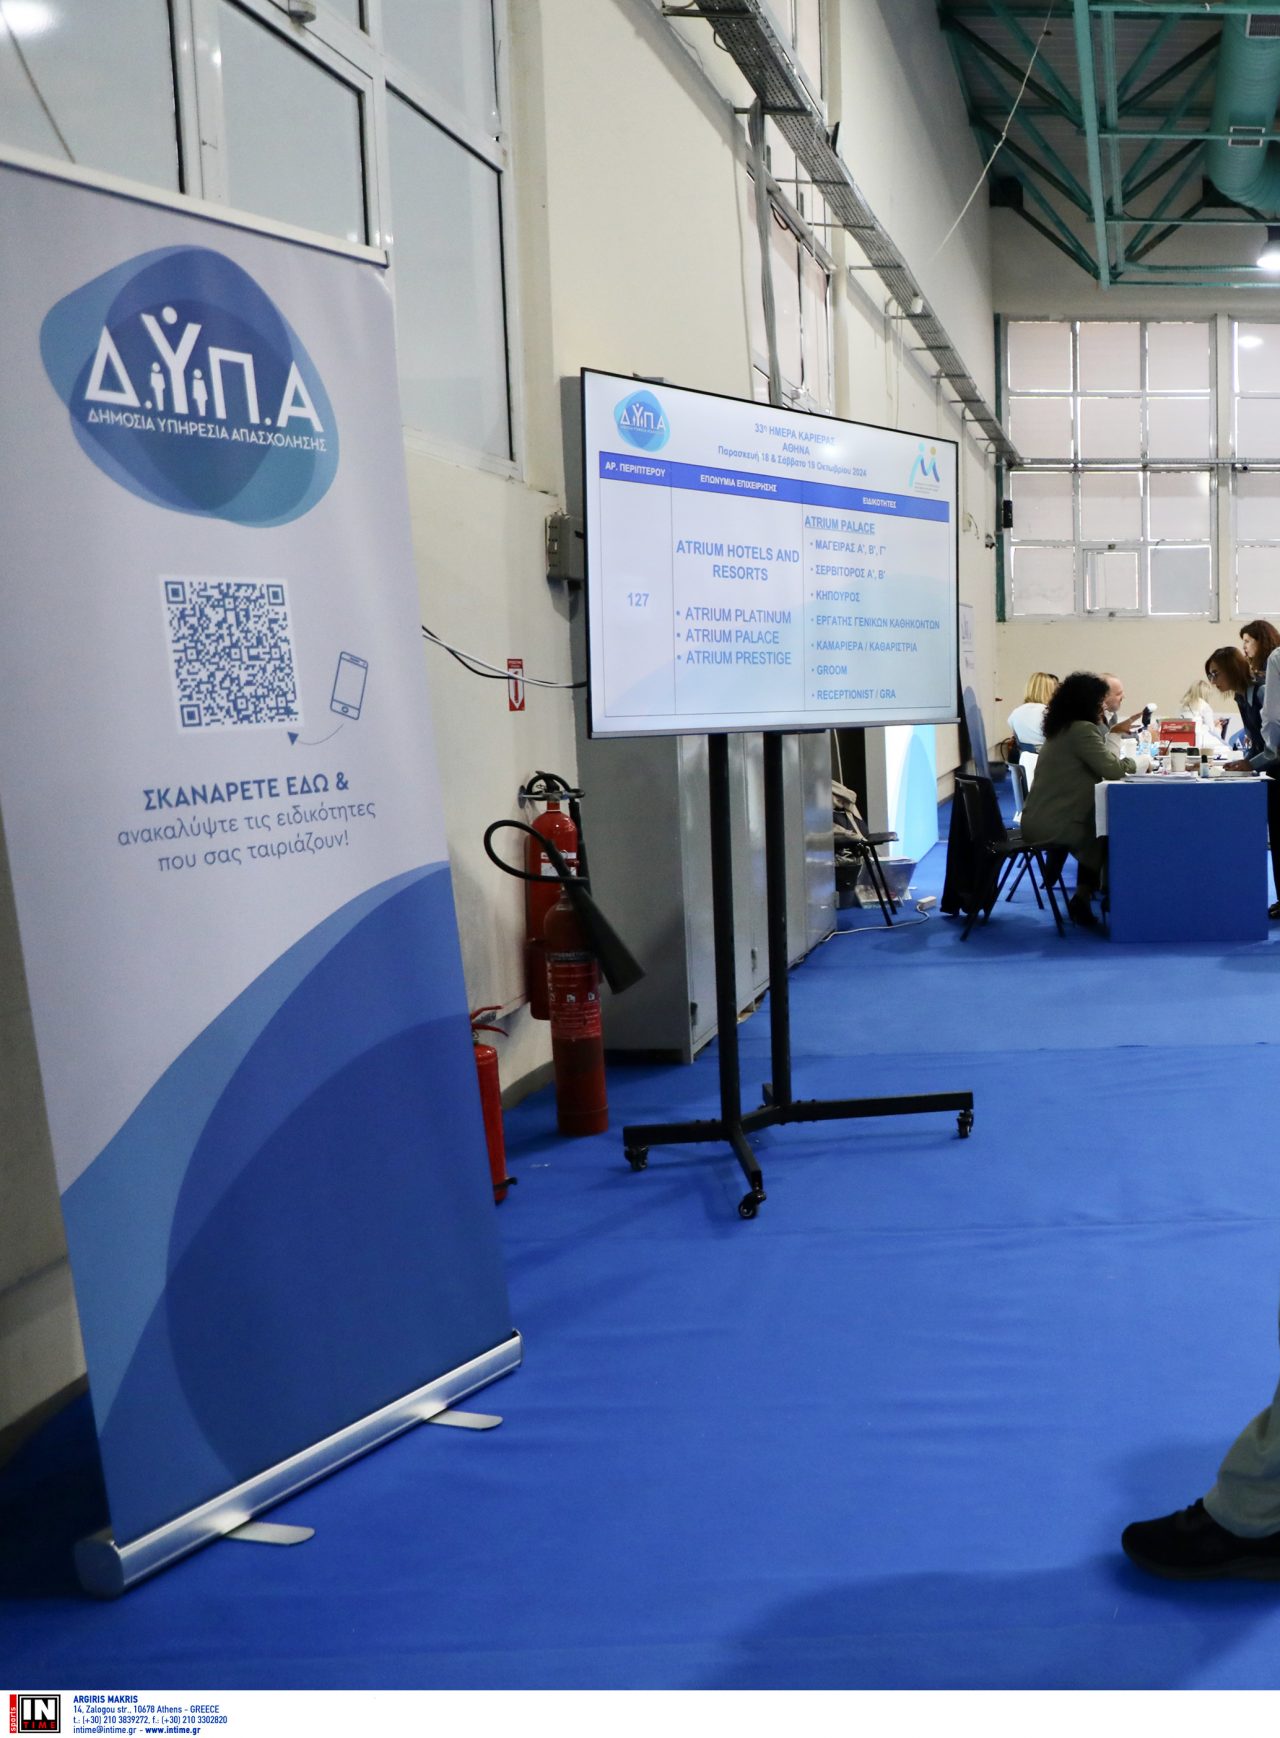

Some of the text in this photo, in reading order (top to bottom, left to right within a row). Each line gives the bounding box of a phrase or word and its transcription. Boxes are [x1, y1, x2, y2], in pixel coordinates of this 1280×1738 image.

[87, 408, 327, 452] ΔΗΜΟΣΙΑ ΥΠΗΡΕΣΙΑ ΑΠΑΣΧΟΛΗΣΗΣ
[769, 426, 797, 439] ΗΜΕΡΑ
[782, 442, 810, 455] ΑΘΗΝΑ
[605, 461, 666, 477] ΑΡ. ΠΕΡΙΠΤΕΡΟΥ
[718, 445, 760, 463] Παρασκευή
[770, 453, 777, 463] &
[777, 455, 806, 468] Σάββατο
[852, 466, 867, 477] 2024
[700, 474, 777, 492] ΕΠΩΝΥΜΙΑ ΕΠΙΧΕΙΡΗΣΗΣ
[804, 515, 875, 534] ATRIUM PALACE
[676, 540, 800, 563] ATRIUM HOTELS AND
[815, 539, 855, 553] ΜΑΓΕΙΡΑΣ
[712, 564, 769, 581] RESORTS
[815, 564, 865, 578] ΣΕΡΒΙΤΟΡΟΣ
[627, 592, 650, 607] 127
[815, 590, 861, 602] ΚΗΠΟΥΡΟΣ
[685, 606, 792, 624] ATRIUM PLATINUM
[816, 615, 940, 629] ΕΡΓΑΤΗΣ ΓΕΝΙΚΩΝ ΚΑΘΗΚΟΝΤΩΝ
[685, 628, 780, 644] ATRIUM PALACE
[816, 640, 863, 651] ΚΑΜΑΡΙΕΡΑ
[869, 641, 918, 652] ΚΑΘΑΡΙΣΤΡΙΑ
[686, 650, 792, 665] ATRIUM PRESTIGE
[816, 665, 848, 675] GROOM
[816, 689, 874, 700] RECEPTIONIST
[143, 771, 349, 811] ΣΚΑΝΑΡΕΤΕ ΕΔΩ &
[117, 801, 377, 846] ανακαλύψτε τις ειδικότητες
[158, 830, 350, 872] που σας ταιριάζουν!
